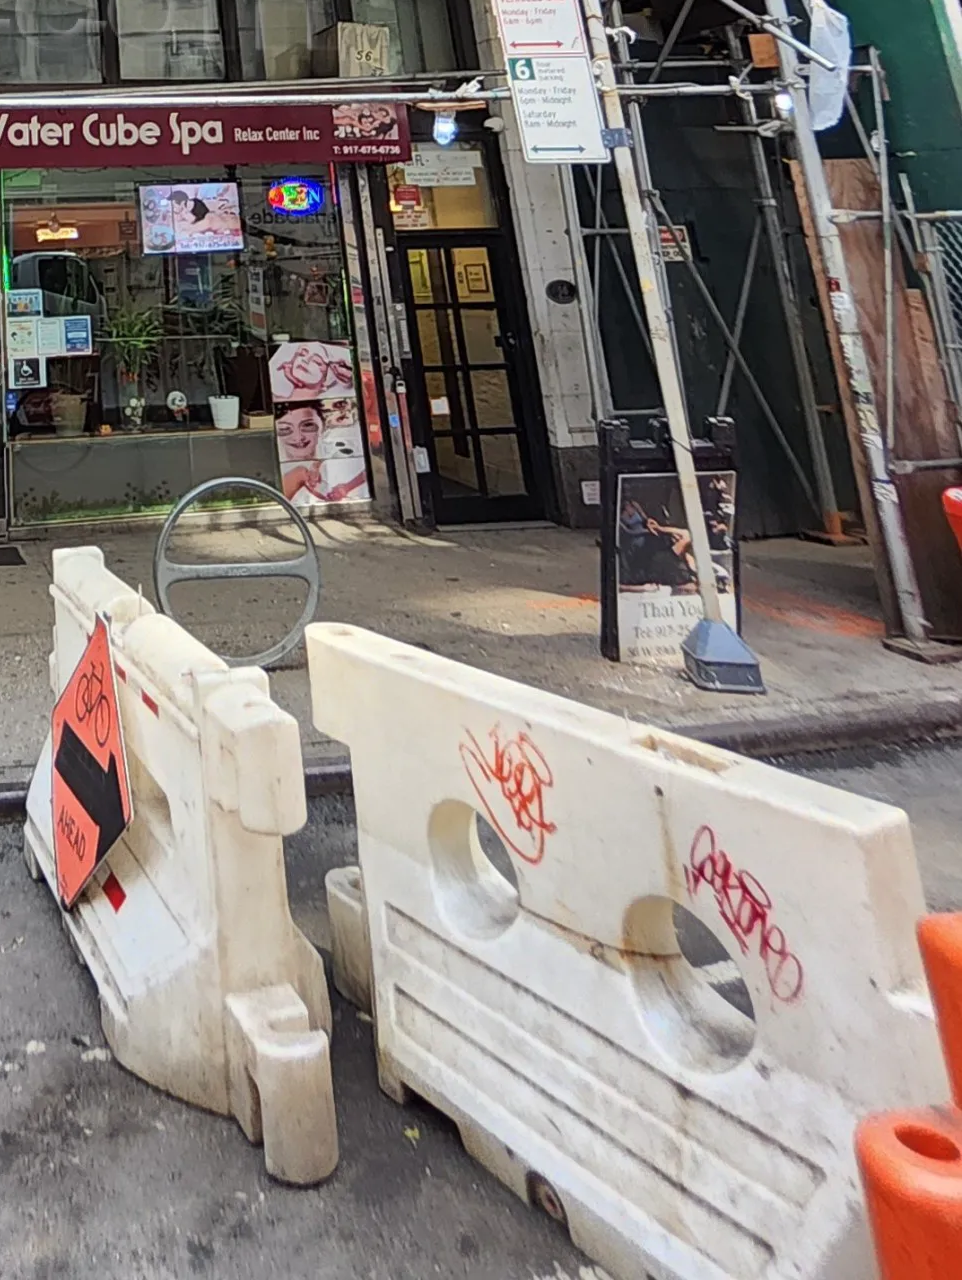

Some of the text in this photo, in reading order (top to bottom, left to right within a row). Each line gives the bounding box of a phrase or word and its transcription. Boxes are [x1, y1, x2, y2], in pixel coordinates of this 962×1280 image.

[534, 7, 557, 15] Friday
[355, 50, 373, 62] 56
[515, 59, 530, 80] 6
[83, 113, 161, 146] Cube
[169, 112, 223, 155] Spa
[234, 127, 263, 142] Relax
[266, 126, 300, 141] Center
[303, 126, 320, 141] Inc
[269, 184, 321, 208] OPEN
[639, 601, 674, 619] Thai
[57, 804, 86, 862] AHEAD
